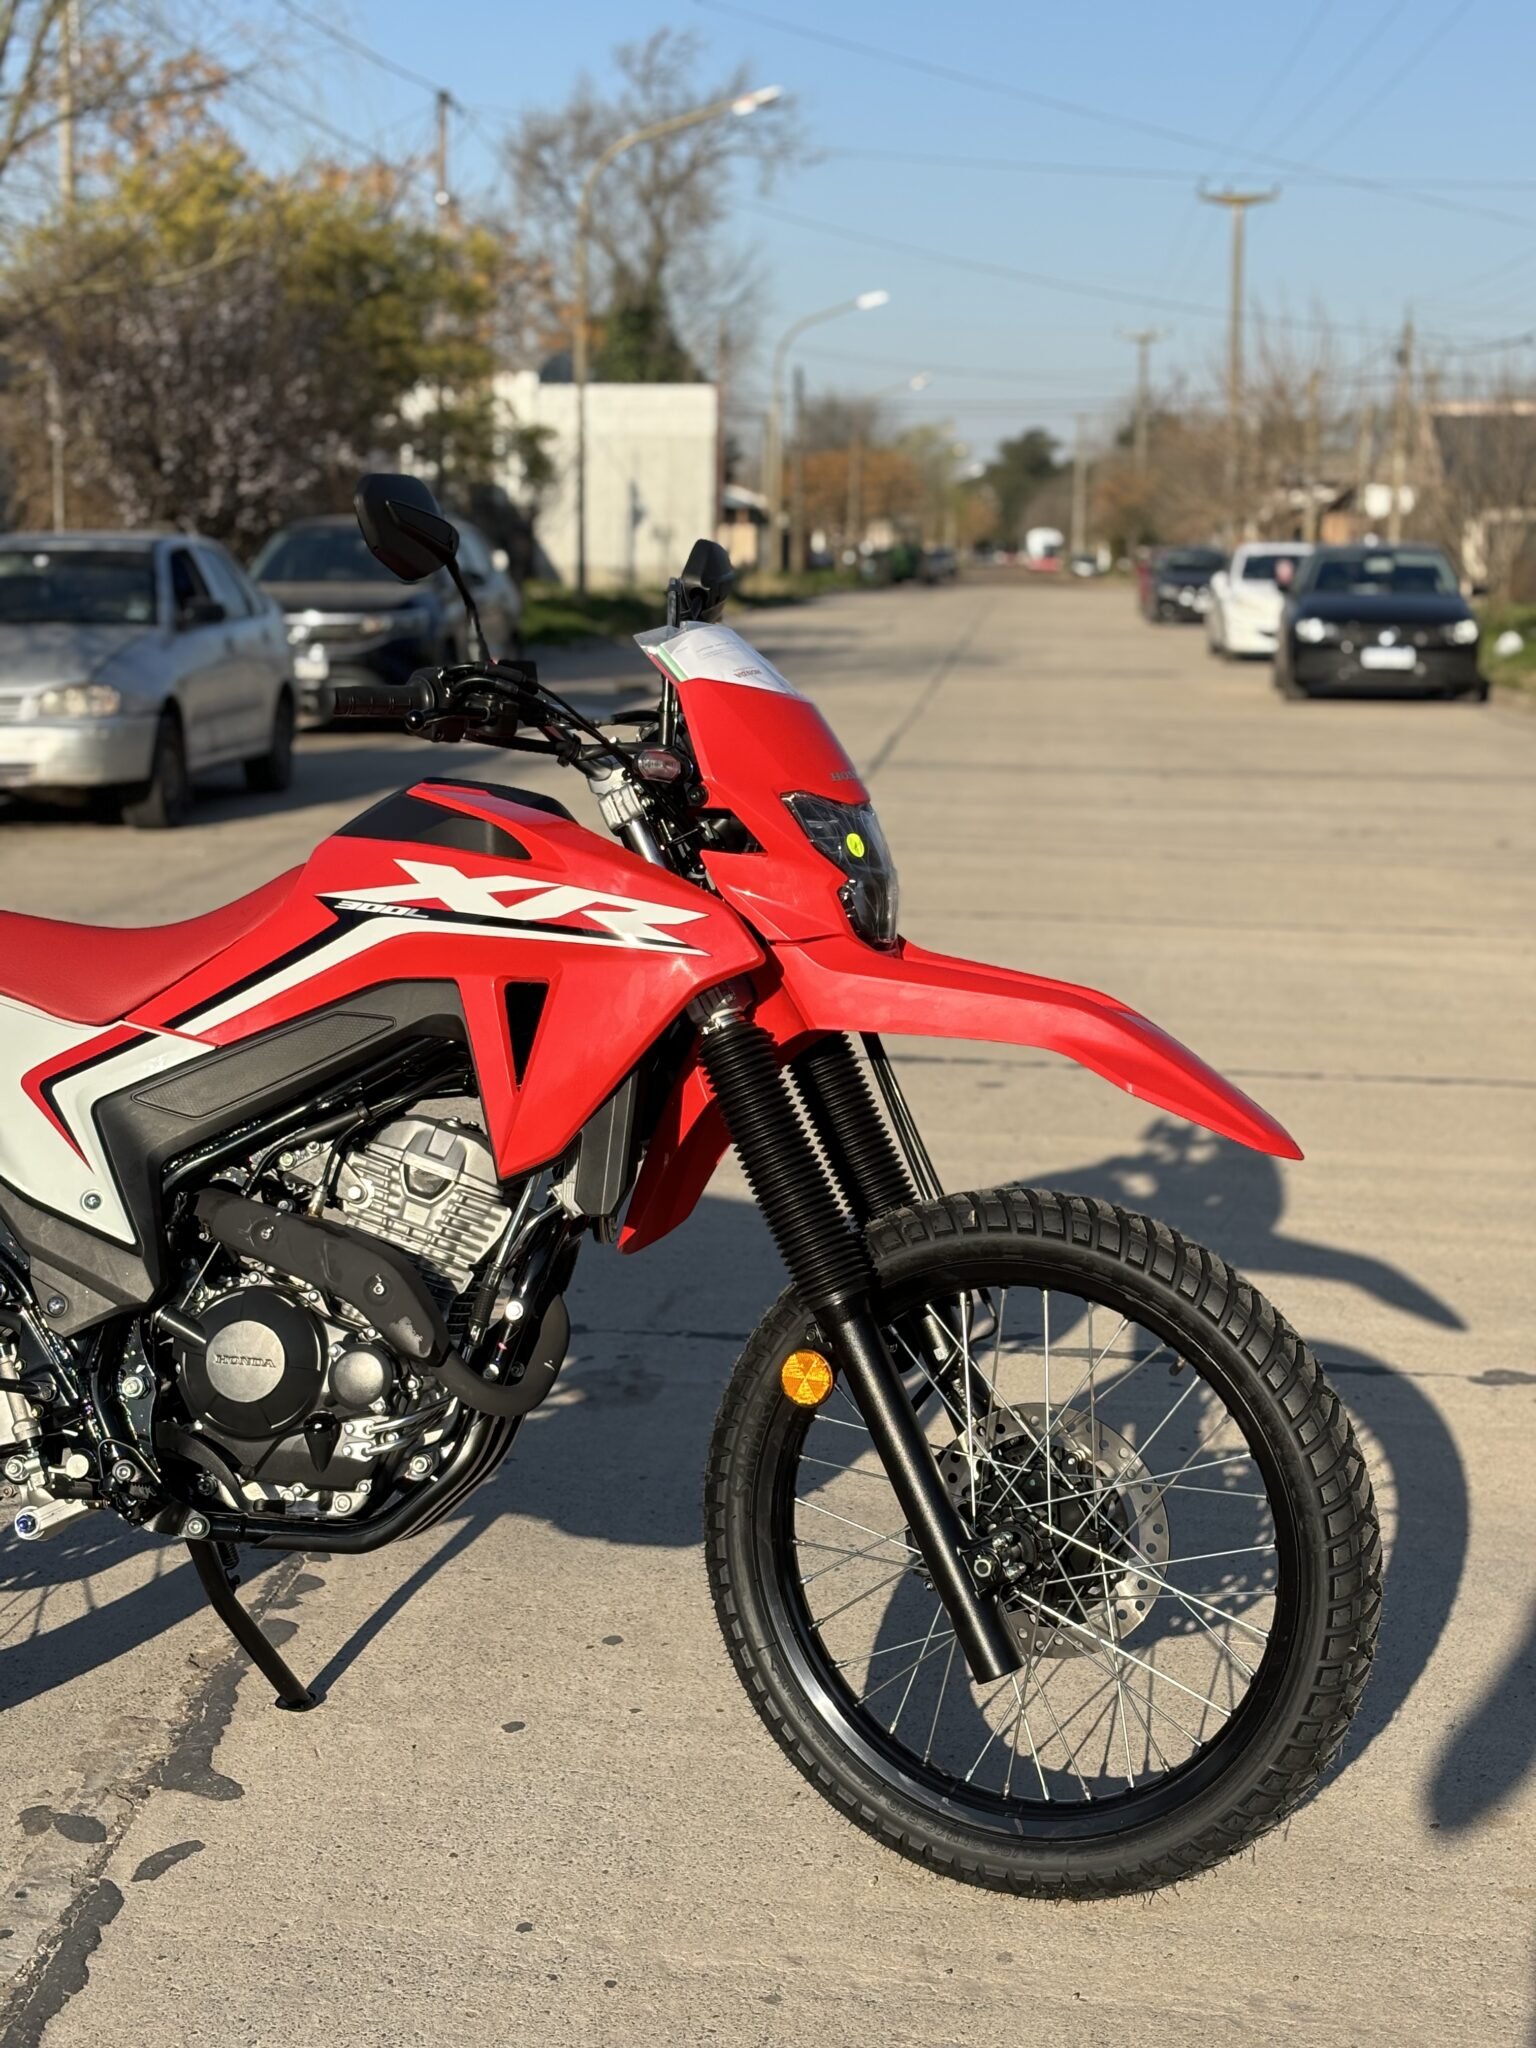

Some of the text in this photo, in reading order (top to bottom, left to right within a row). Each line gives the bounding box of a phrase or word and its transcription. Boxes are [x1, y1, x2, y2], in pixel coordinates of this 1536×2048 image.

[314, 858, 710, 945] XR
[334, 899, 429, 919] 300L
[215, 1354, 277, 1369] HONDA
[735, 1387, 779, 1514] SAHARA
